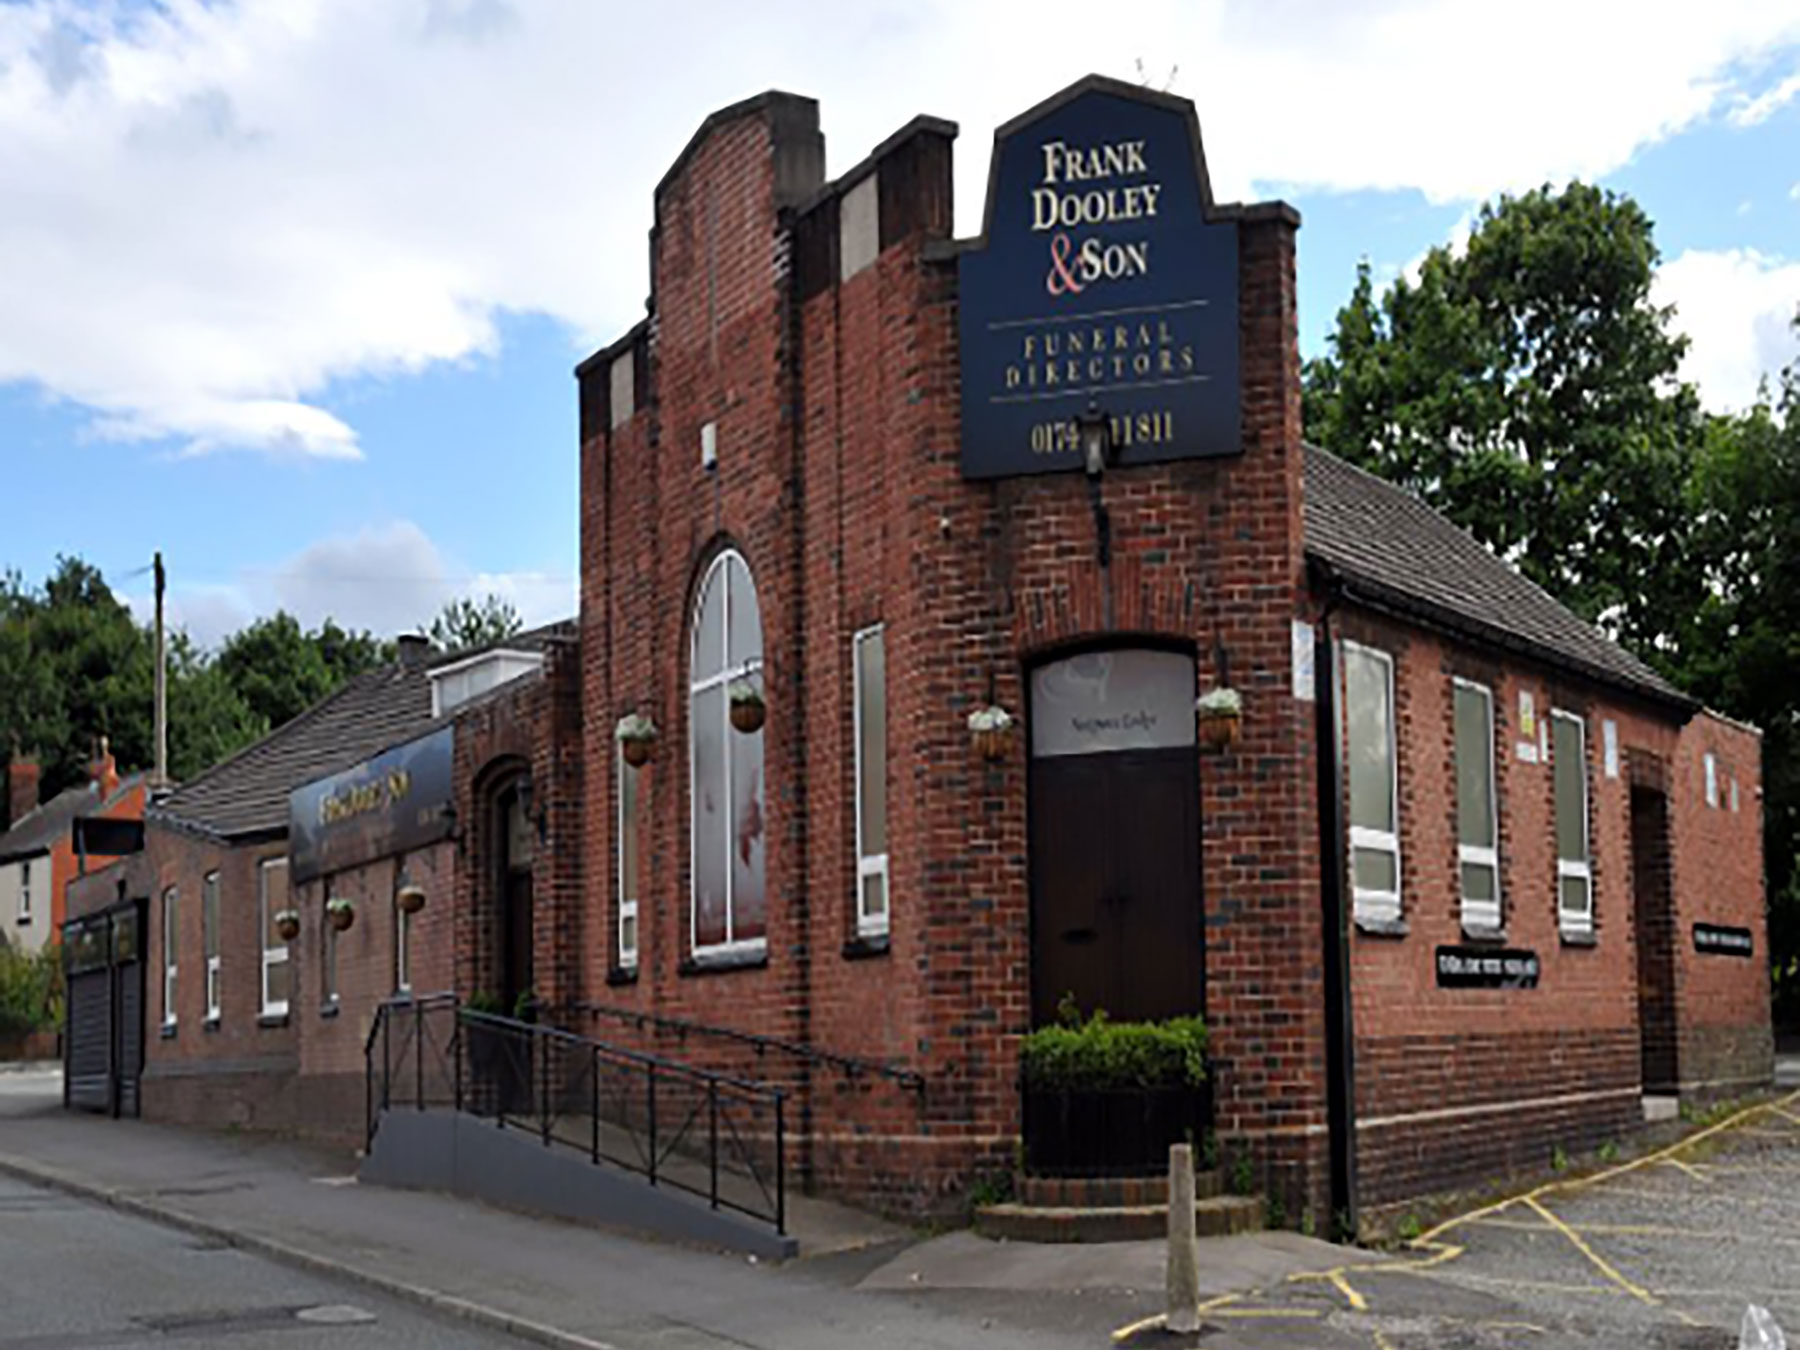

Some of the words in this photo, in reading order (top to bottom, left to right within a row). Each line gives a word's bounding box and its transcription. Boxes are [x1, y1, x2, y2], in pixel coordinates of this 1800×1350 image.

[1042, 140, 1147, 183] FRANK
[1031, 184, 1161, 231] DOOLEY
[1024, 321, 1172, 360] FUNERAL
[1006, 345, 1194, 388] DIRECTORS
